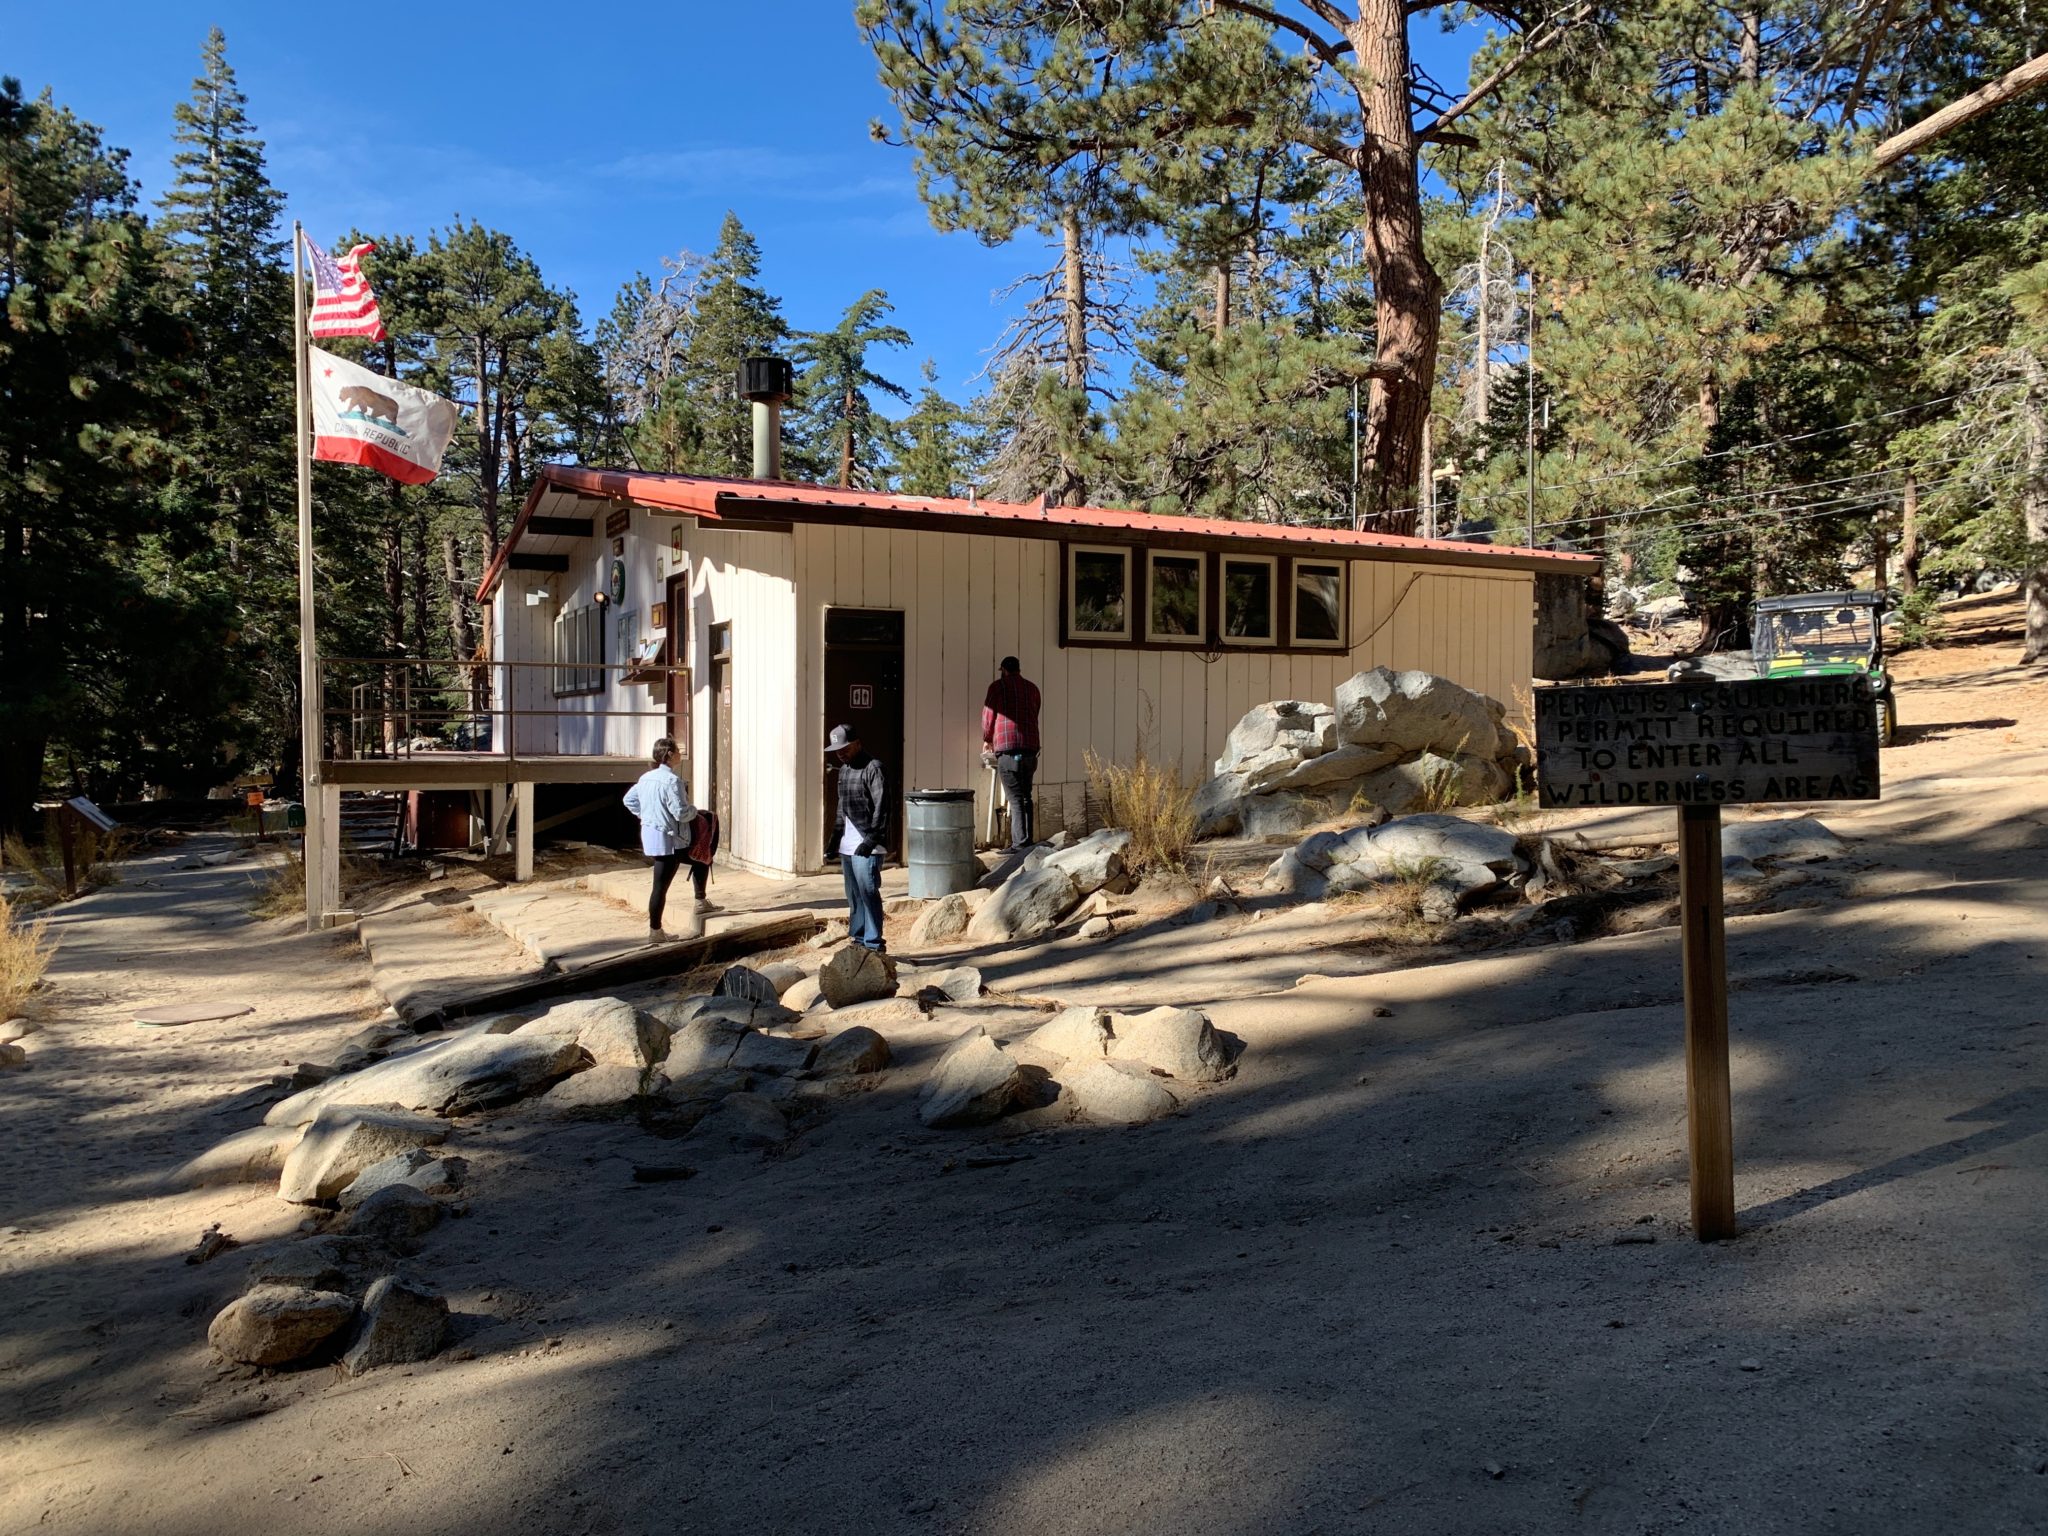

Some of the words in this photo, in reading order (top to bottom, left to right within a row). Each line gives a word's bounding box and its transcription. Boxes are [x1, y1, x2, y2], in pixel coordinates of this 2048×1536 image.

[363, 427, 411, 455] REPUBLIC
[1541, 690, 1668, 716] PERMITS
[1677, 684, 1788, 711] ISSUED
[1799, 680, 1867, 706] HERE
[1558, 716, 1678, 743] PERMIT
[1697, 710, 1871, 739] REQUIRED
[1574, 746, 1617, 770] TO
[1627, 743, 1722, 769] ENTER
[1737, 740, 1799, 765] ALL
[1546, 779, 1746, 805] WILDERNESS
[1764, 774, 1871, 800] AREAS
